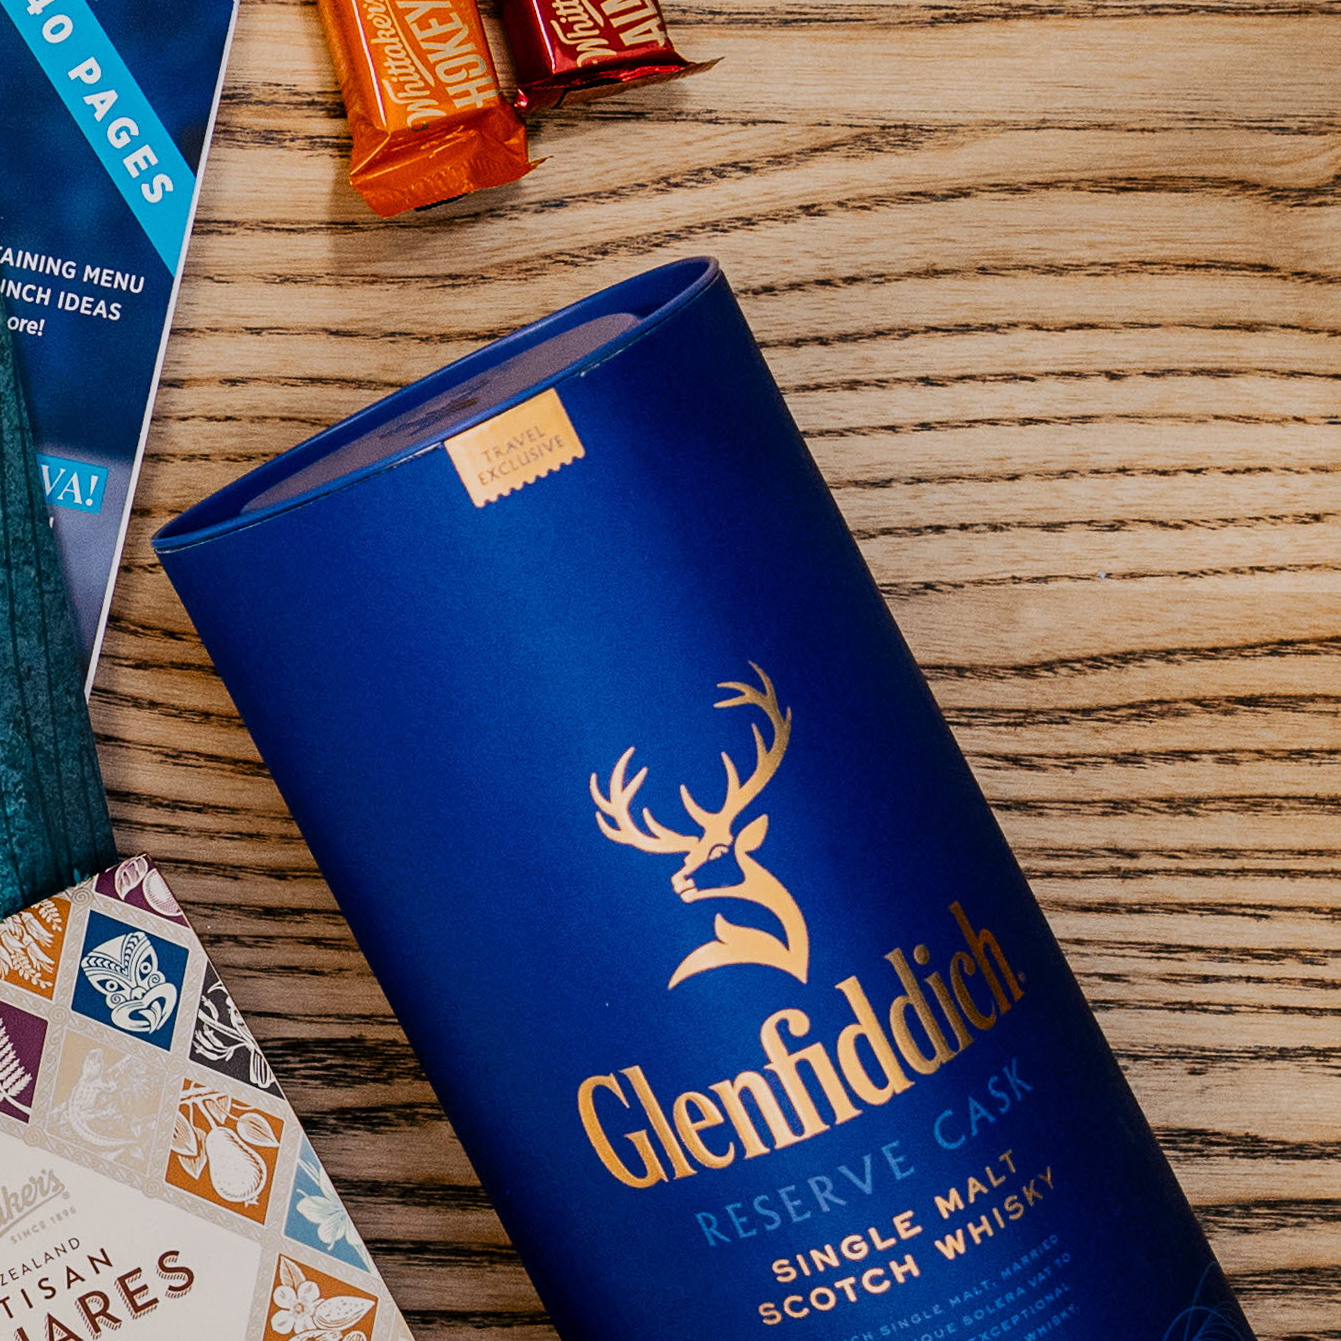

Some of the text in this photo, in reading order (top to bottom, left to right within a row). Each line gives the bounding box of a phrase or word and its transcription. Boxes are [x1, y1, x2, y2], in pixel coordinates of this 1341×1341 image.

[395, 0, 502, 109] HOKEY
[67, 56, 175, 205] PAGES
[84, 265, 145, 295] MENU
[57, 292, 121, 321] IDEAS
[478, 435, 564, 486] EXCLUSIVE
[482, 426, 545, 463] TRAVEL
[576, 900, 1024, 1189] Glenfiddich
[695, 1058, 1033, 1247] RESERVE CASK
[9, 1206, 77, 1245] SINCE 1896
[771, 1150, 1017, 1284] SINGLE MALT
[758, 1166, 1056, 1325] SCOTCH WHISKY
[880, 1305, 943, 1336] SINGLE
[963, 1286, 1026, 1326] SOLERA
